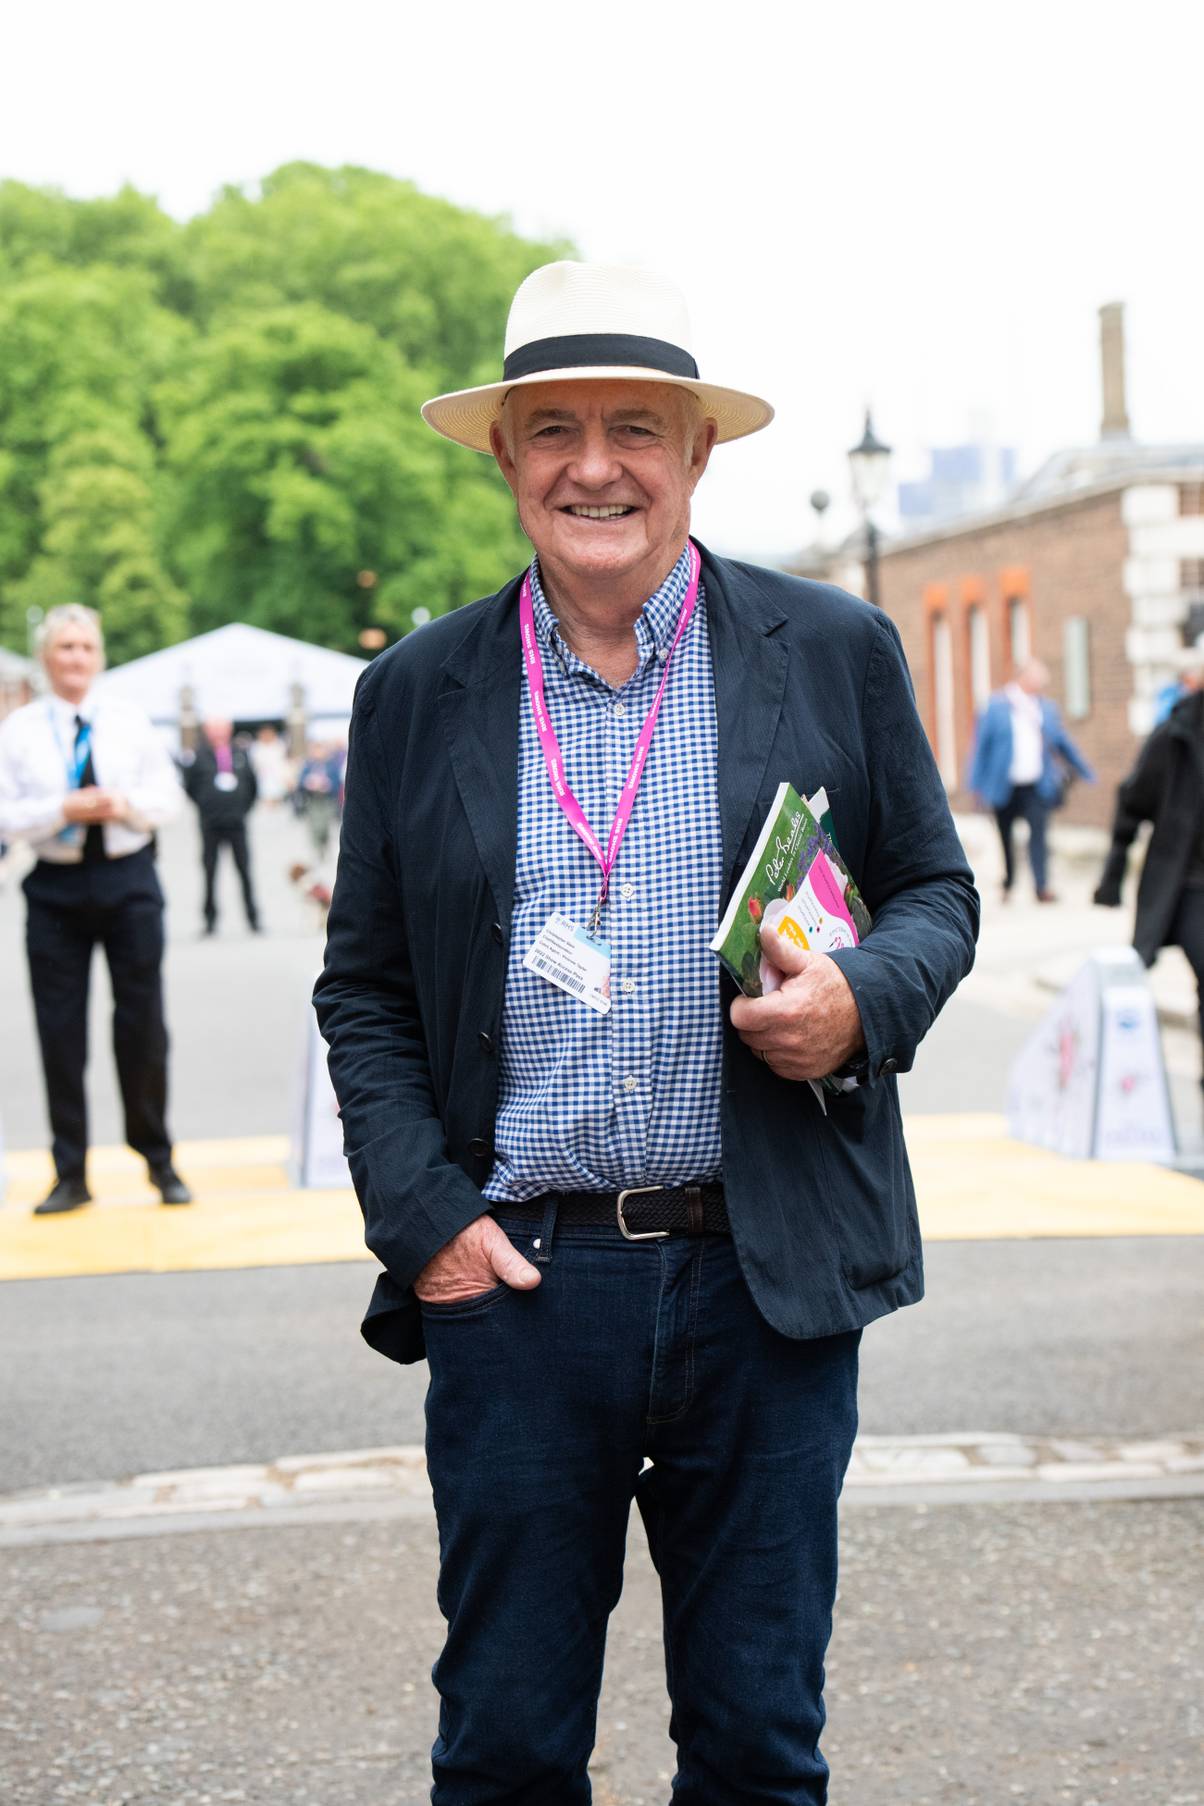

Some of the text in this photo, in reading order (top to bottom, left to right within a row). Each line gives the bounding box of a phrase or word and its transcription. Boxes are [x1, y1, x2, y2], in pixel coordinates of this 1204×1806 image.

[523, 623, 536, 664] RHS SHOWS
[534, 689, 547, 732] RHS SHOWS
[551, 758, 565, 796] RHS SHOWS
[628, 746, 645, 789] RHS SHOWS
[614, 818, 623, 834] RHS
